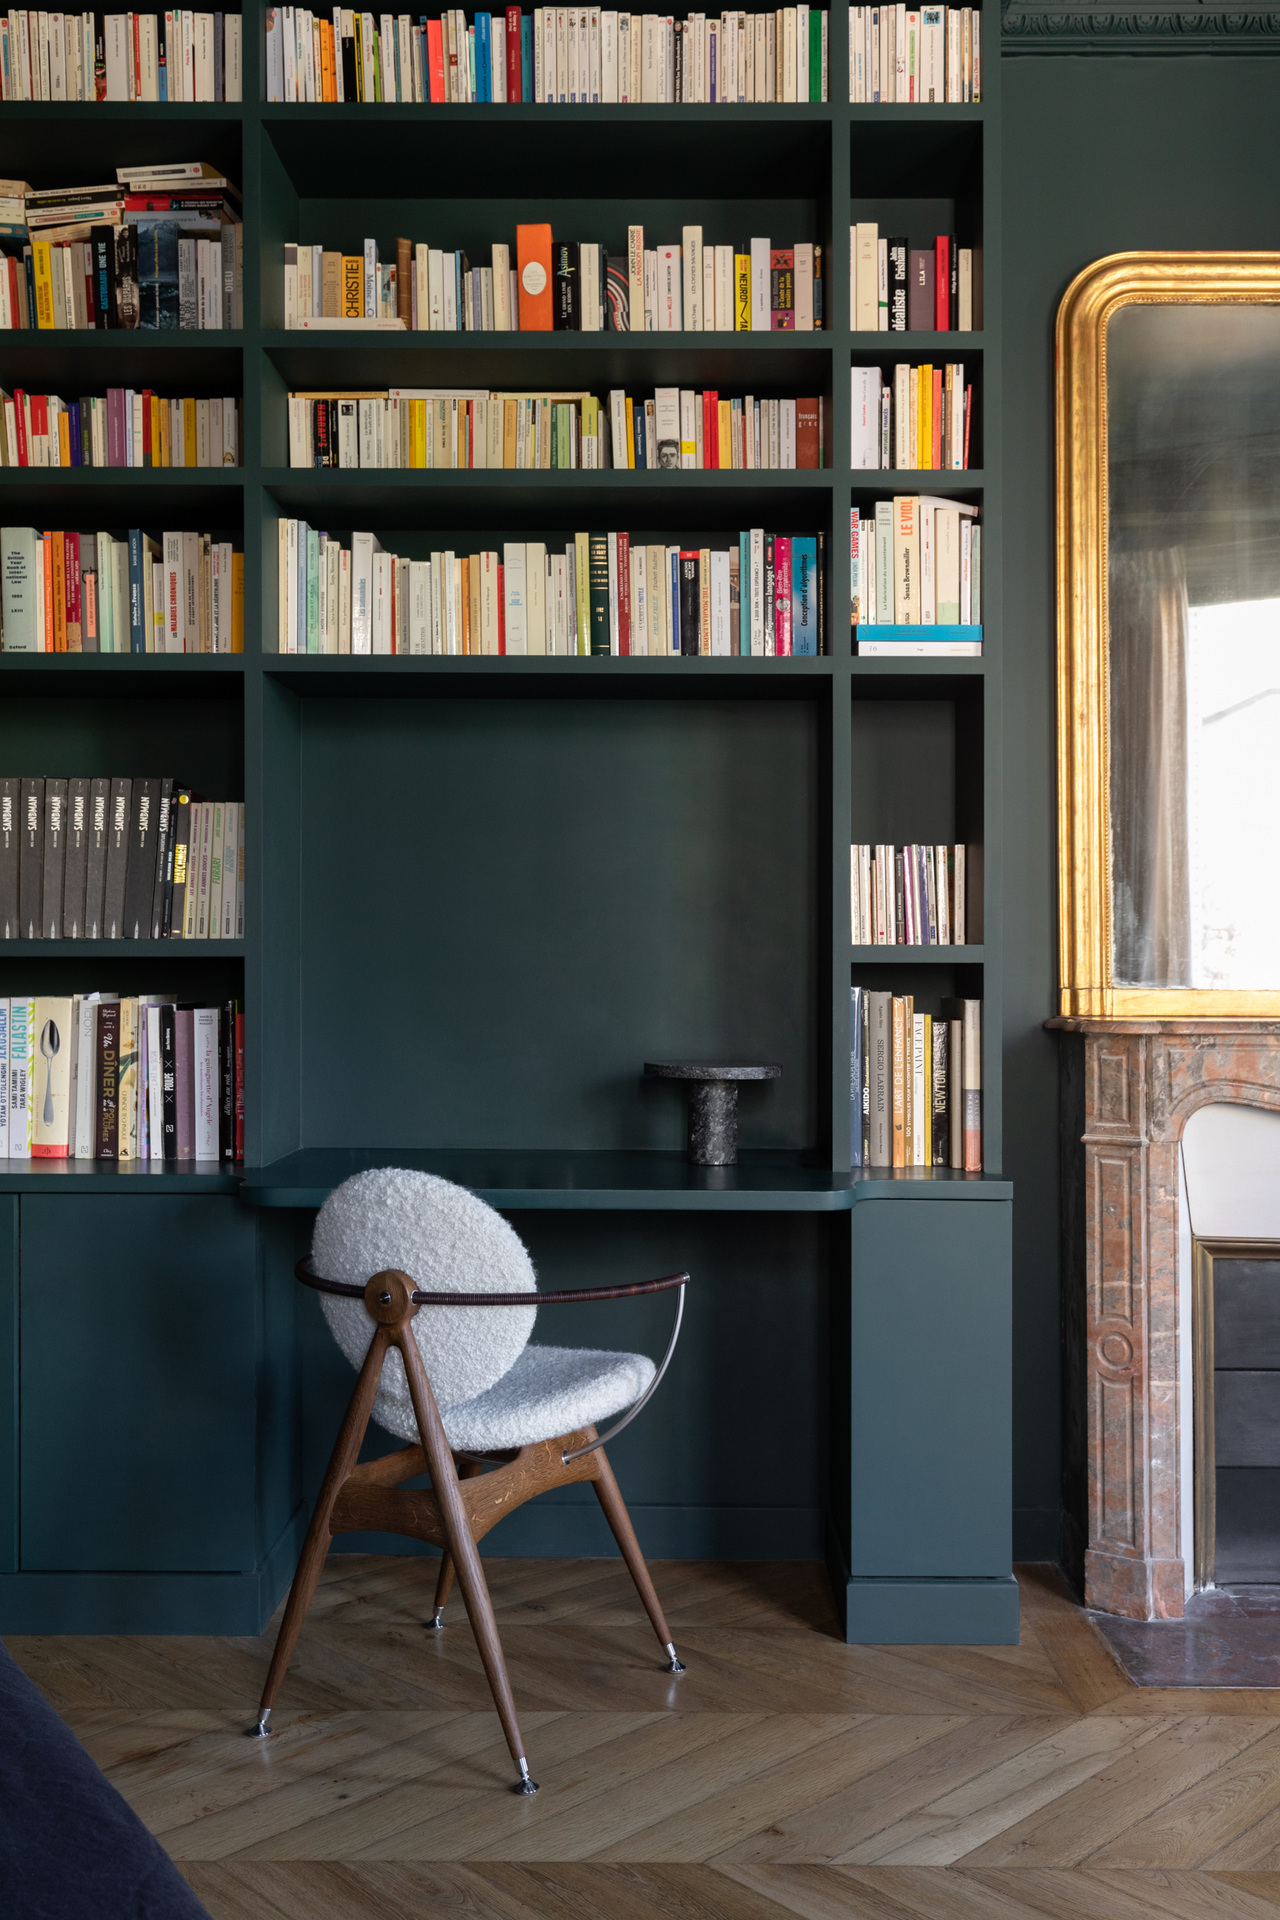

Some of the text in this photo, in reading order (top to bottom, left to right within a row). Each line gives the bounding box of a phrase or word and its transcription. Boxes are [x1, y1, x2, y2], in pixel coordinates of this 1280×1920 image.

[557, 247, 576, 277] Asimov
[895, 247, 905, 280] Grisham
[100, 270, 108, 310] CASTORIADIS
[225, 271, 233, 292] DIEU
[345, 264, 359, 318] CHRISTIE
[636, 278, 642, 286] LA
[123, 305, 133, 315] LES
[317, 404, 326, 447] HARRAP'S
[900, 500, 913, 535] LE VIOL
[766, 571, 774, 595] langage
[800, 554, 809, 626] Conception d'algorithmes
[3, 797, 12, 831] SANDMAN
[28, 796, 37, 830] SANDMAN
[51, 797, 60, 830] SANDMAN
[74, 797, 83, 830] SANDMAN
[95, 797, 104, 831] SANDMAN
[115, 797, 125, 831] SANDMAN
[139, 797, 150, 831] SANDMAN
[160, 798, 170, 832] SANDMAN
[174, 844, 187, 883] WATCHMEN
[212, 858, 221, 884] FURARI
[12, 1006, 27, 1059] FALASTIN
[103, 1034, 113, 1048] Un
[914, 1022, 923, 1076] FACE PAINT
[103, 1050, 117, 1097] DÎNER
[894, 1016, 903, 1113] L'ART DE L'ENFANCE
[165, 1073, 174, 1091] POULPE
[935, 1070, 946, 1113] NEWTON
